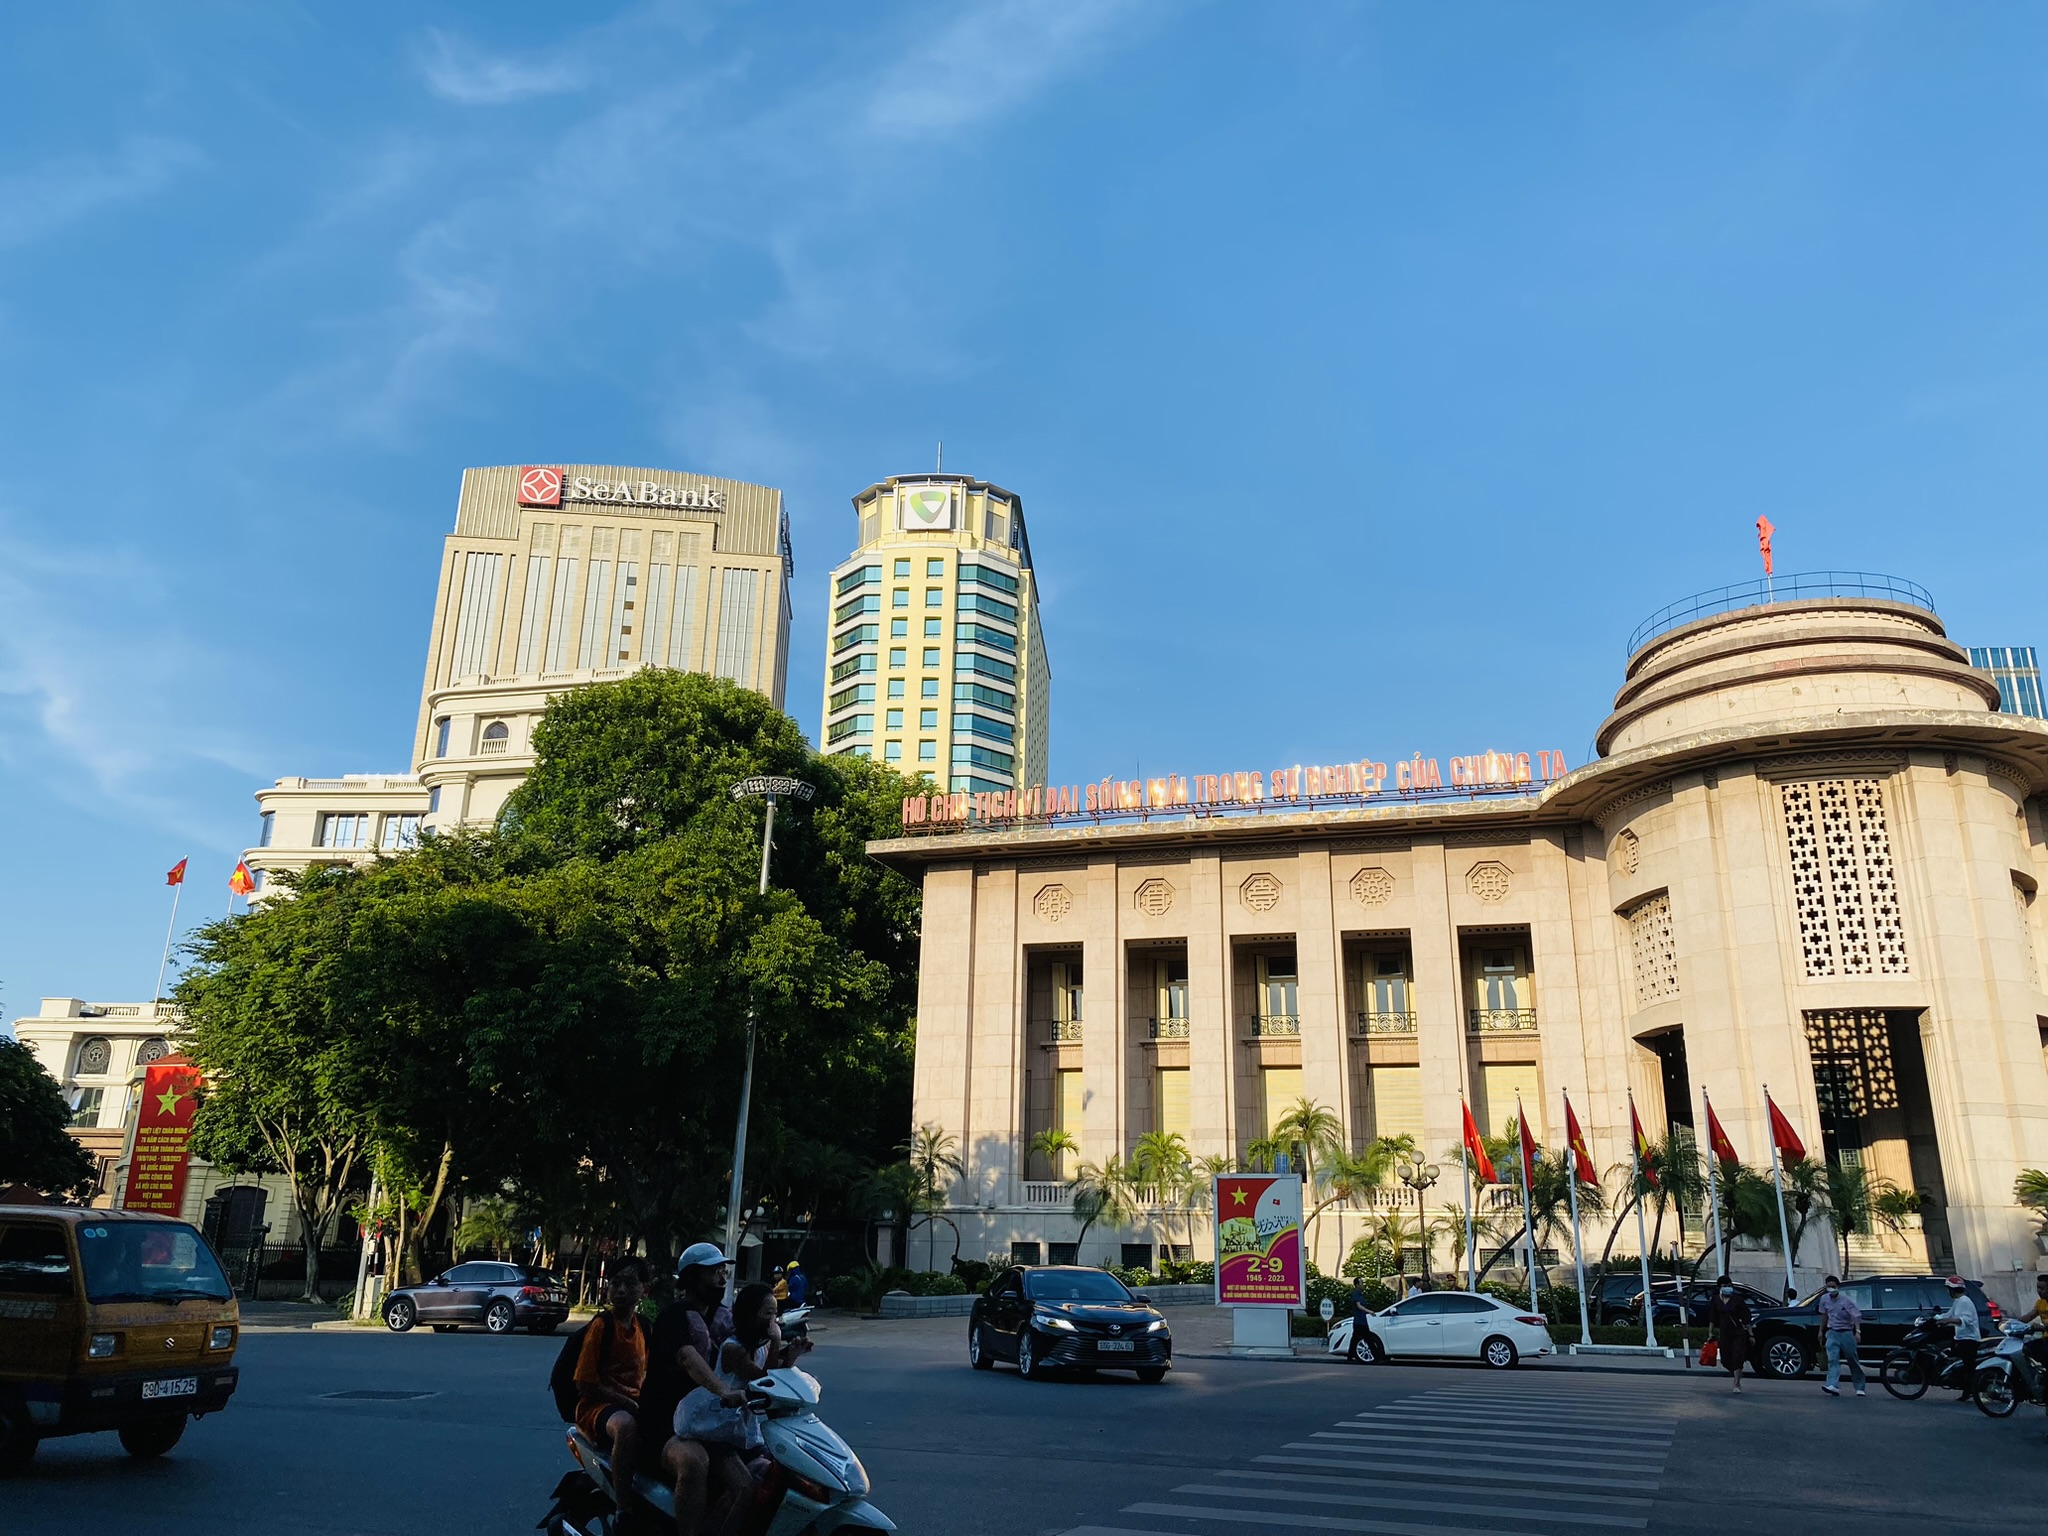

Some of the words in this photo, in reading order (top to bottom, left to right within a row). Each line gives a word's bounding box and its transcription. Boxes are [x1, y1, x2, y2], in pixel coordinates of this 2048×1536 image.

[572, 476, 721, 509] SeABank
[902, 790, 927, 824] HỒ
[931, 787, 970, 822] CHỦ
[974, 789, 1018, 824] TỊCH
[1086, 774, 1143, 811] SỐNG
[1193, 771, 1264, 803] TRONG
[1305, 758, 1387, 798] NGHIỆP
[1396, 751, 1442, 789] CỦA
[1450, 749, 1532, 786] CHÚNG
[1537, 749, 1568, 780] TA
[1247, 1257, 1283, 1273] 2-9
[1246, 1274, 1262, 1282] 1945
[1268, 1274, 1285, 1282] 2023
